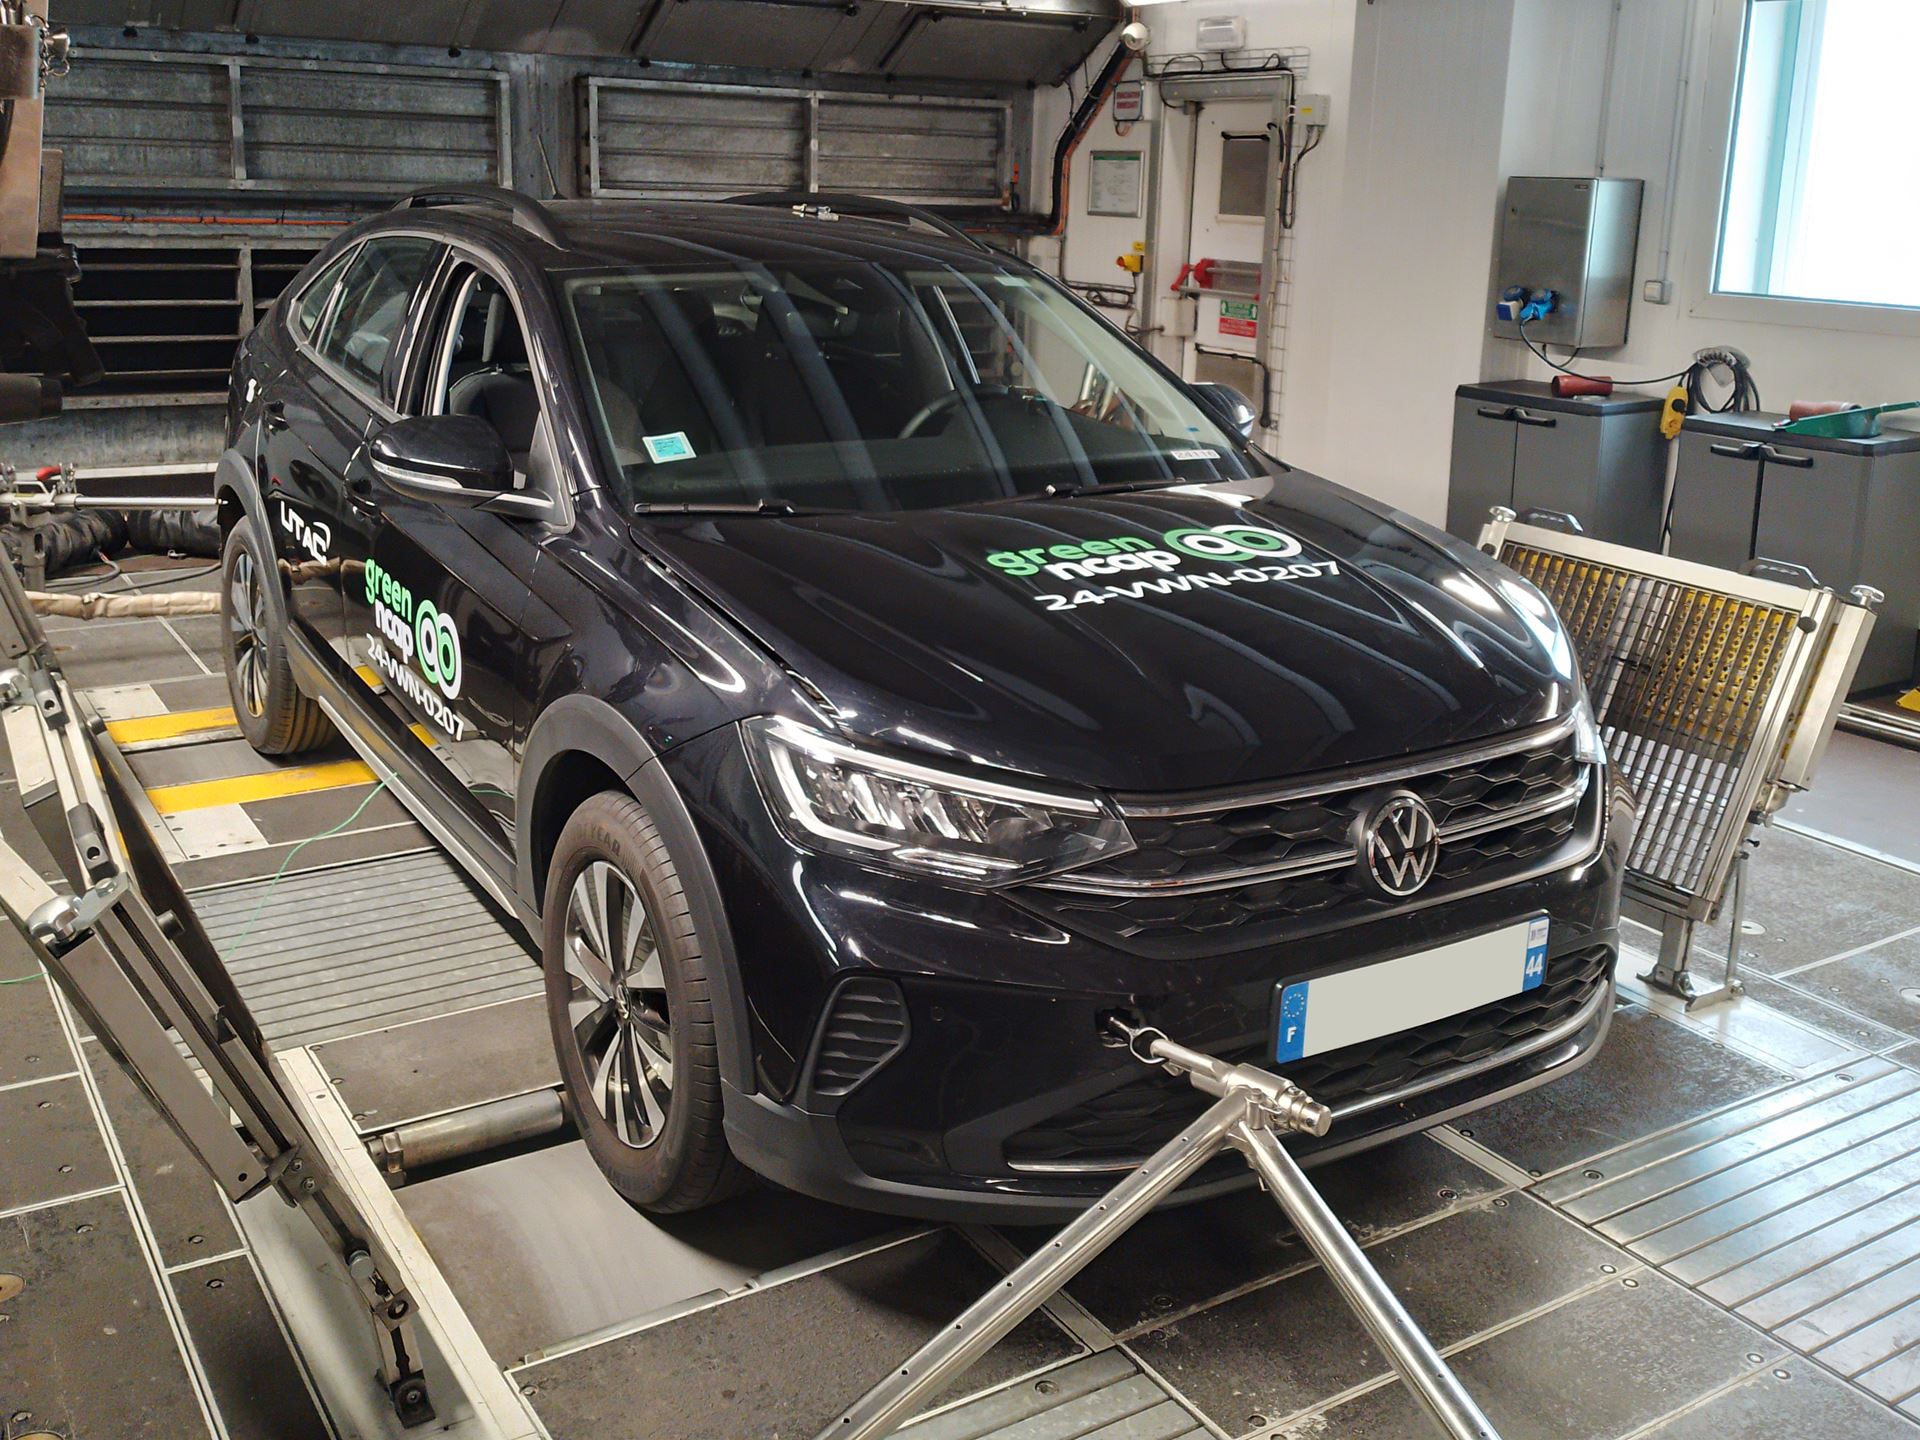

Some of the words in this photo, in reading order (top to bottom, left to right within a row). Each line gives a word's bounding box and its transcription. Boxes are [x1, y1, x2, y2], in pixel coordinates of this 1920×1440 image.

[280, 500, 331, 566] UTAC
[986, 535, 1155, 576] green
[1035, 561, 1340, 611] 24-VWN-0207
[1045, 547, 1180, 581] ncap
[364, 558, 412, 624] green
[374, 598, 414, 664] ncap
[366, 632, 465, 742] 24-VWN-0207
[1526, 953, 1543, 977] 44
[1286, 1027, 1297, 1043] F
